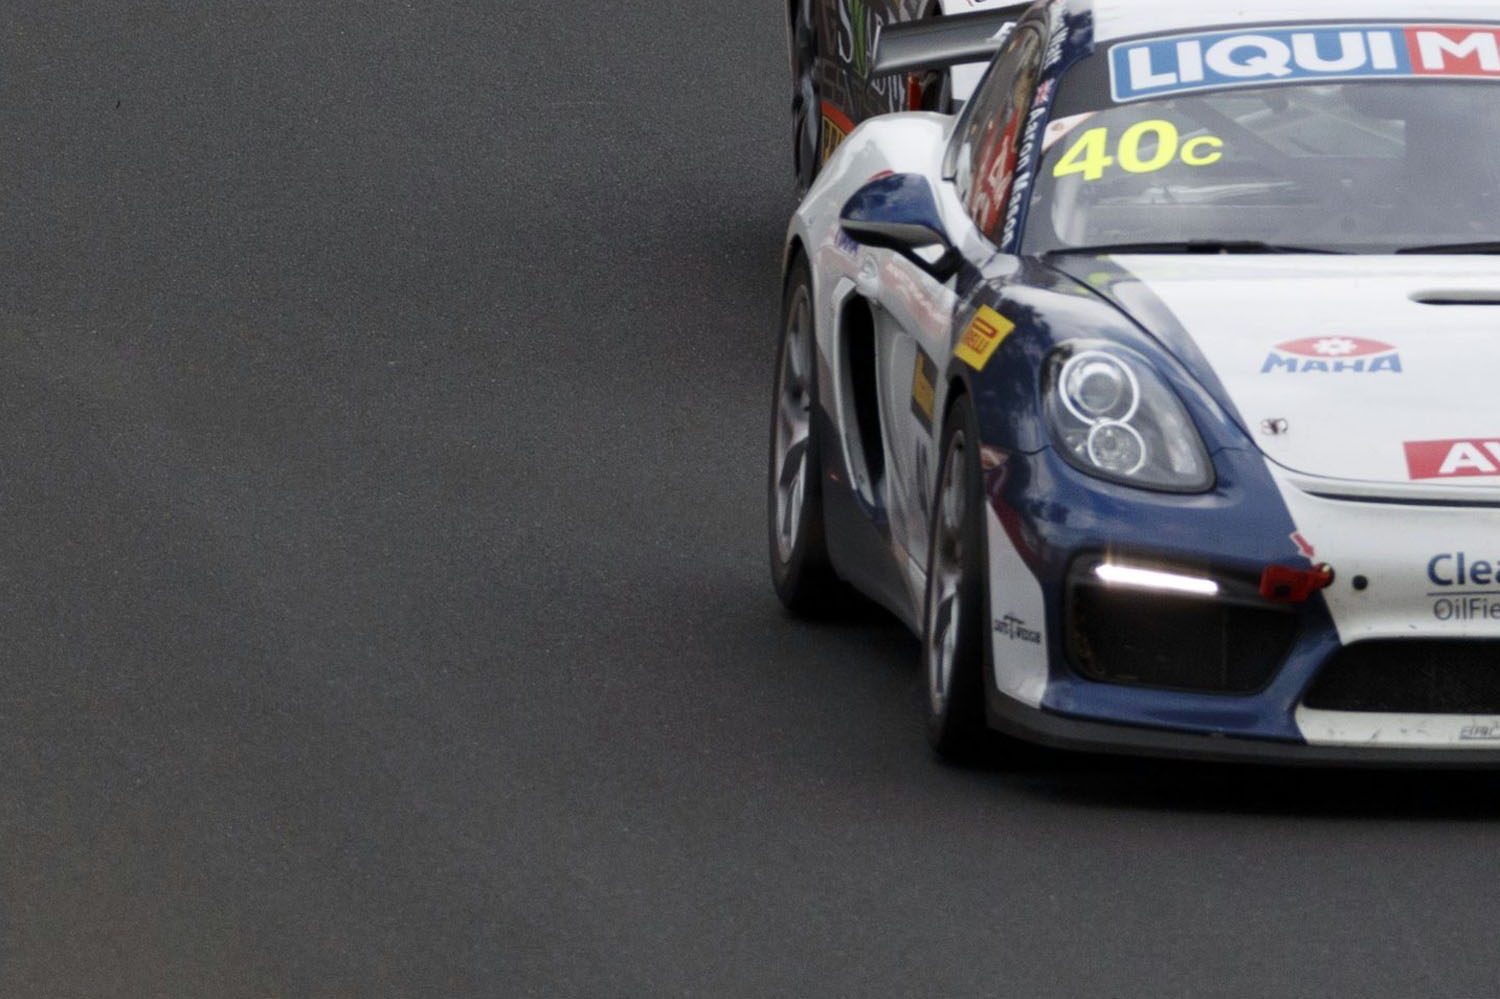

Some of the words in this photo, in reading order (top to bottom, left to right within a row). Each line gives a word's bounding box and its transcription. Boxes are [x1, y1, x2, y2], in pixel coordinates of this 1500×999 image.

[1128, 30, 1398, 90] LIQUI
[1014, 105, 1047, 173] Aaron
[1000, 170, 1030, 248] Mason
[1260, 351, 1403, 374] MAHA
